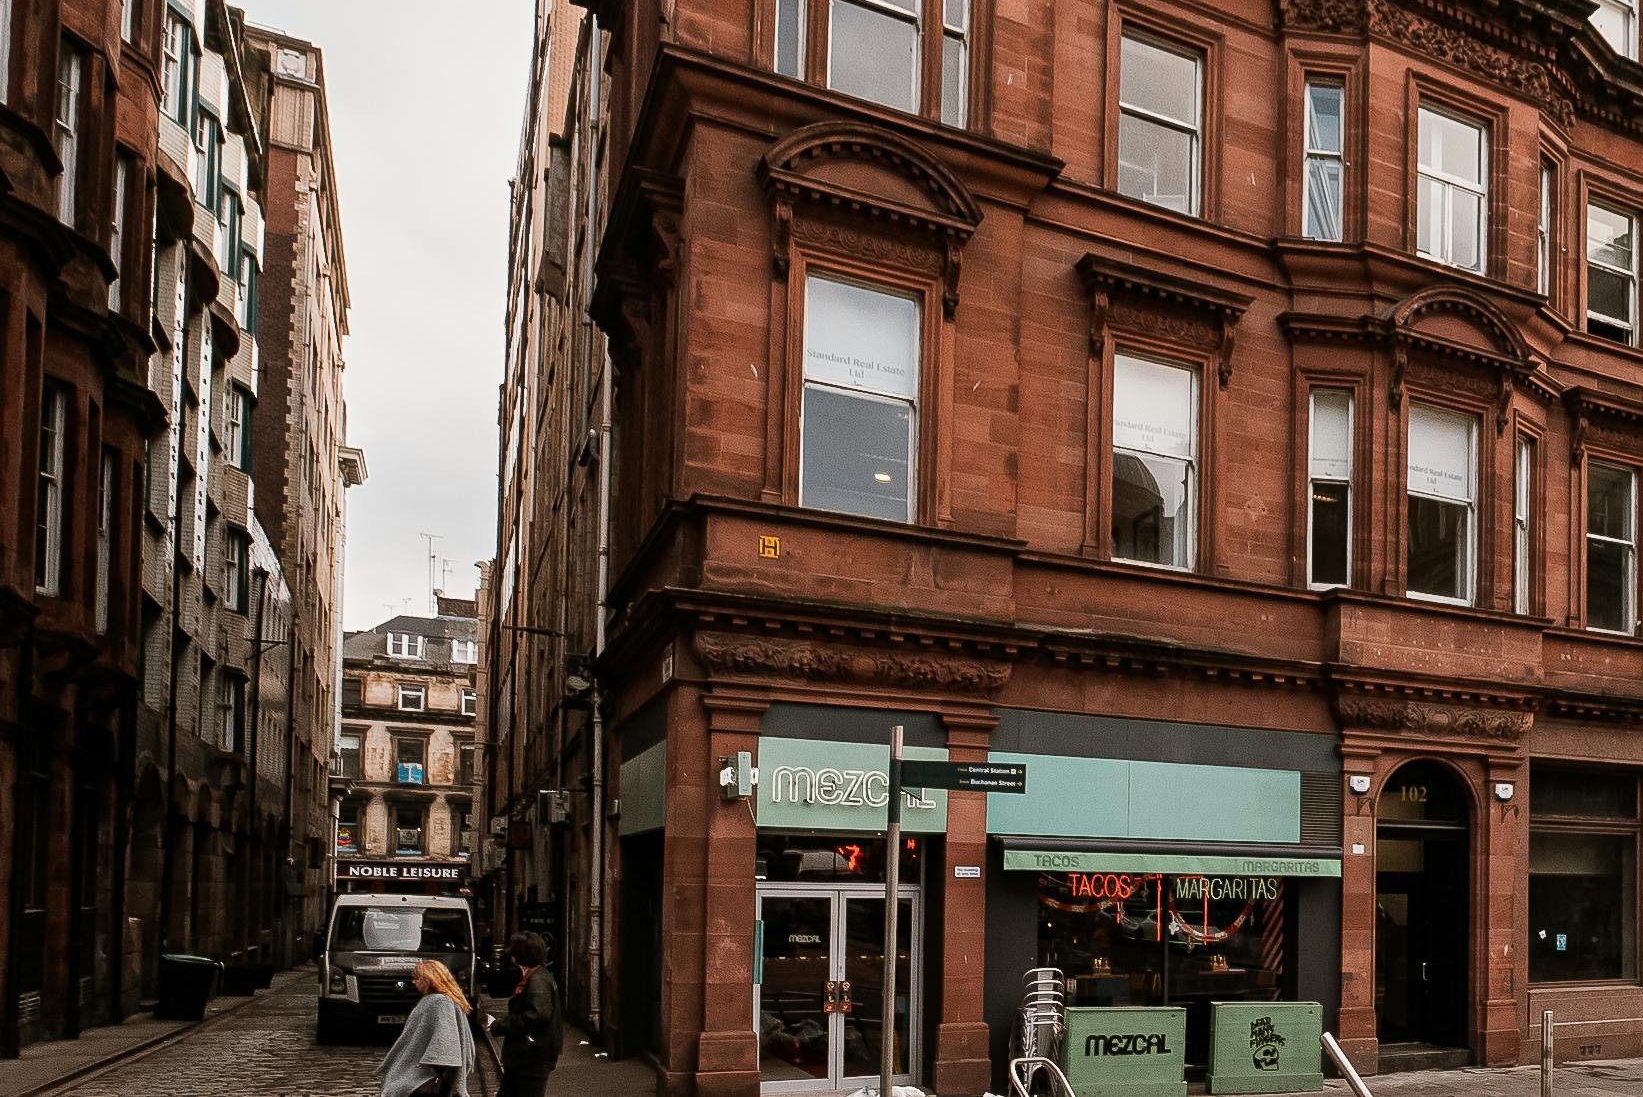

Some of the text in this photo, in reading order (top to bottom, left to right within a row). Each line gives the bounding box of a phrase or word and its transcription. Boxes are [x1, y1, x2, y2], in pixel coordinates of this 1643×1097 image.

[807, 349, 905, 377] Standard Real Estate
[849, 368, 865, 379] Ltd
[1144, 423, 1162, 434] Real
[1163, 427, 1186, 439] Estate
[968, 766, 990, 775] Central
[990, 767, 1010, 775] Station
[970, 778, 998, 786] Buchanan
[998, 779, 1016, 787] Street
[1401, 785, 1428, 802] 102
[1033, 854, 1320, 873] TACOS MARGARITAS
[349, 866, 459, 878] NOBLE LEISURE
[1068, 873, 1278, 900] TACOS MARGARITAS
[788, 934, 822, 943] MEZCAL
[1085, 1033, 1172, 1057] MEZCAL
